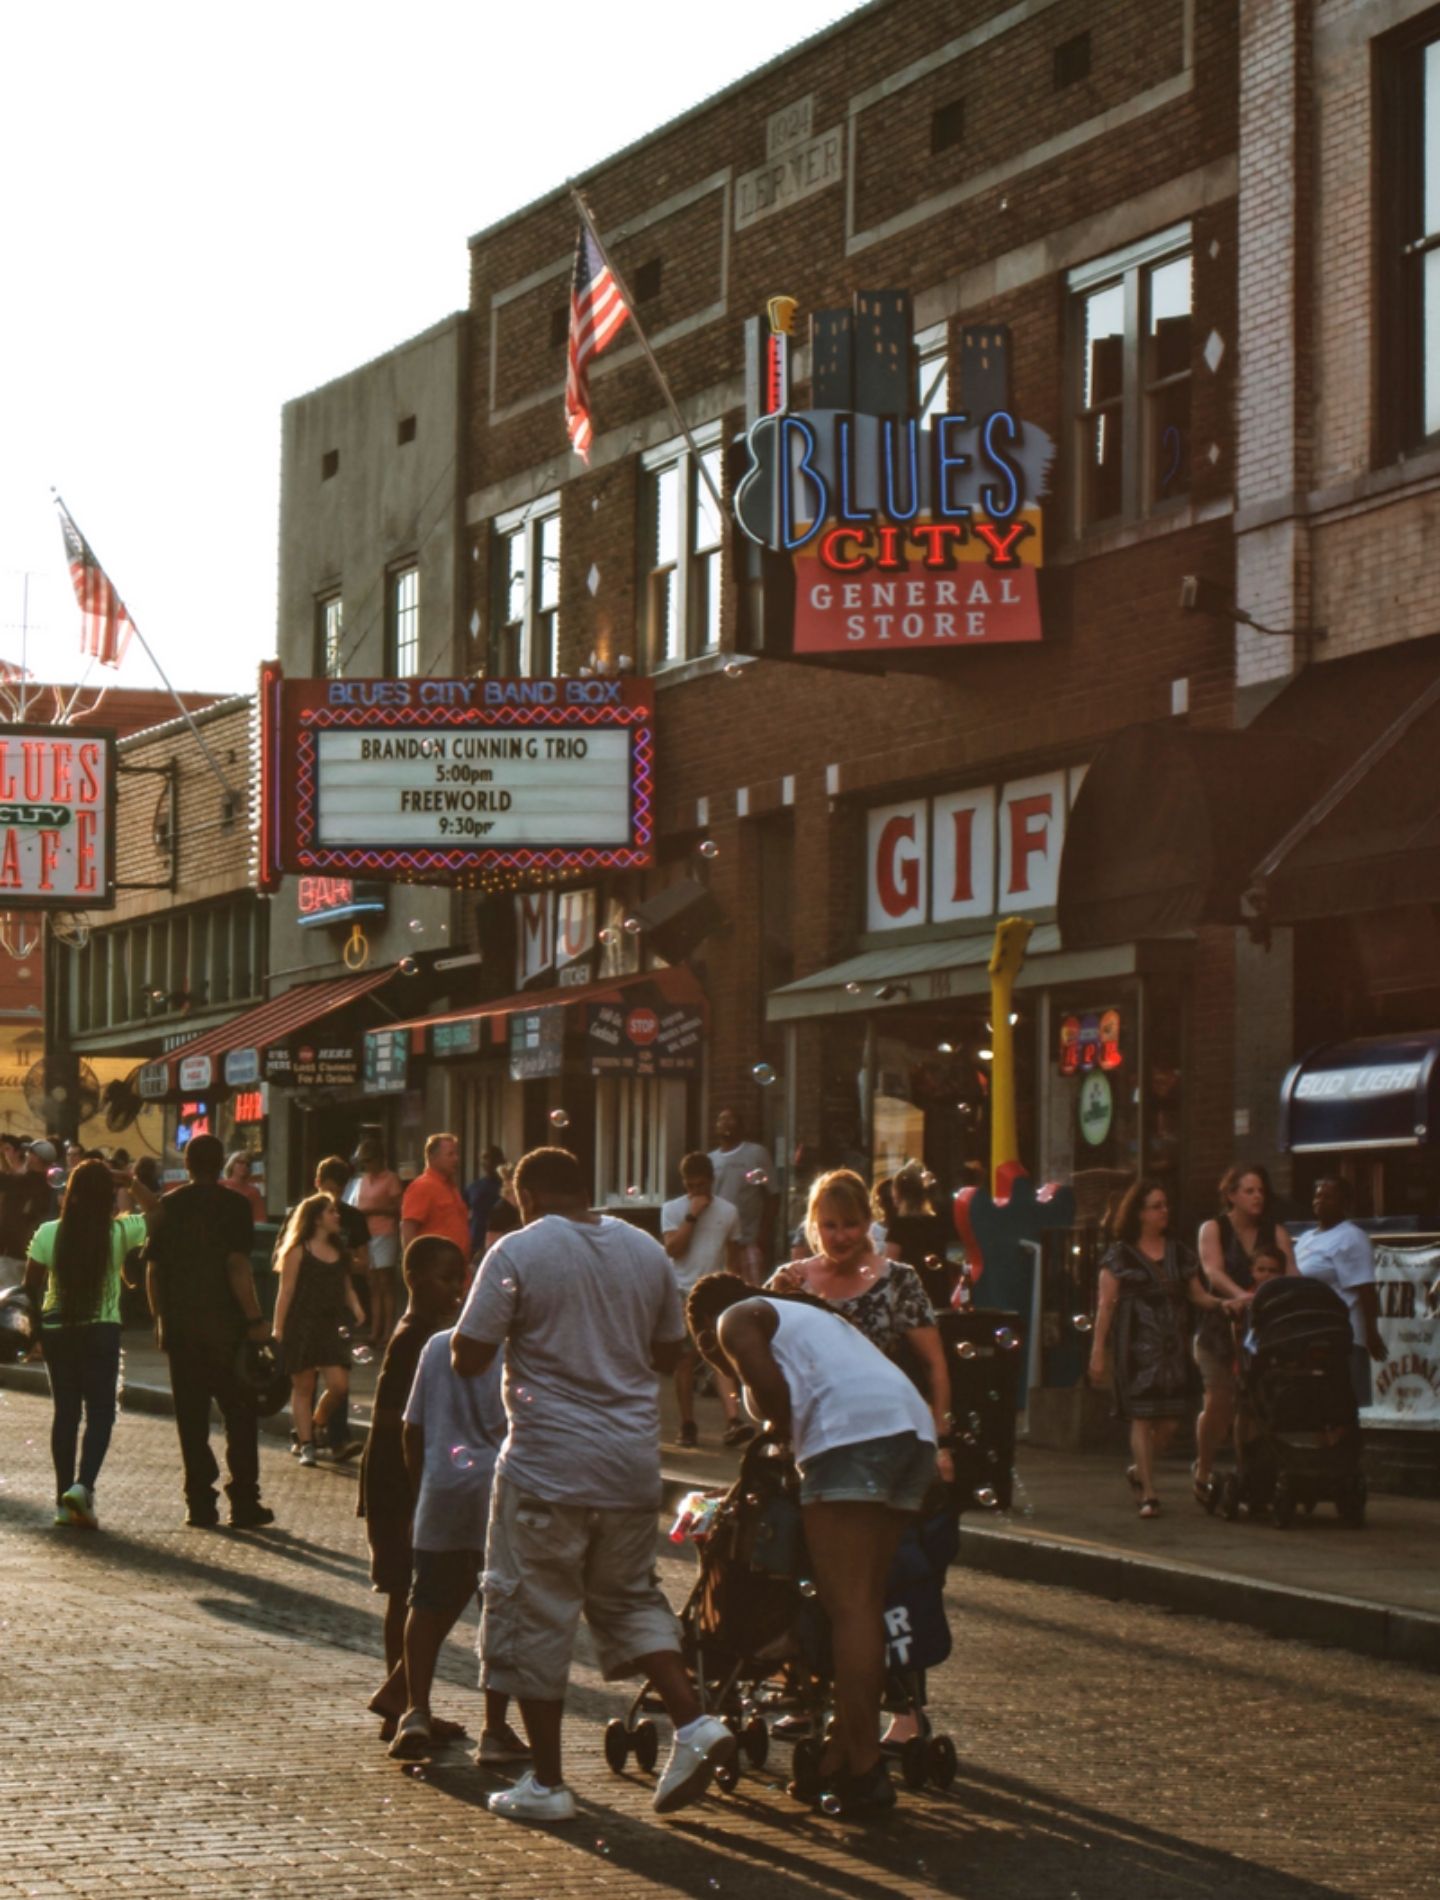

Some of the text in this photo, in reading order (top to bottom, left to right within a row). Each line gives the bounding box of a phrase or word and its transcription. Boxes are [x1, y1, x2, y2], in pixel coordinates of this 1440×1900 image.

[770, 102, 811, 151] 1924
[739, 136, 839, 219] LERNER
[780, 411, 1022, 550] BLUES
[818, 522, 1034, 573] CITY
[810, 578, 1021, 610] GENERAL
[847, 611, 986, 640] STORE
[328, 680, 622, 705] BLUES CITY BAND BOX
[361, 738, 588, 760] BRANDON CUNNING TRIO
[435, 765, 493, 786] 5:00pm
[401, 790, 512, 812] FREEWORLD
[876, 793, 1053, 918] GIF
[630, 1019, 656, 1033] STOP
[1295, 1074, 1345, 1098] BUD
